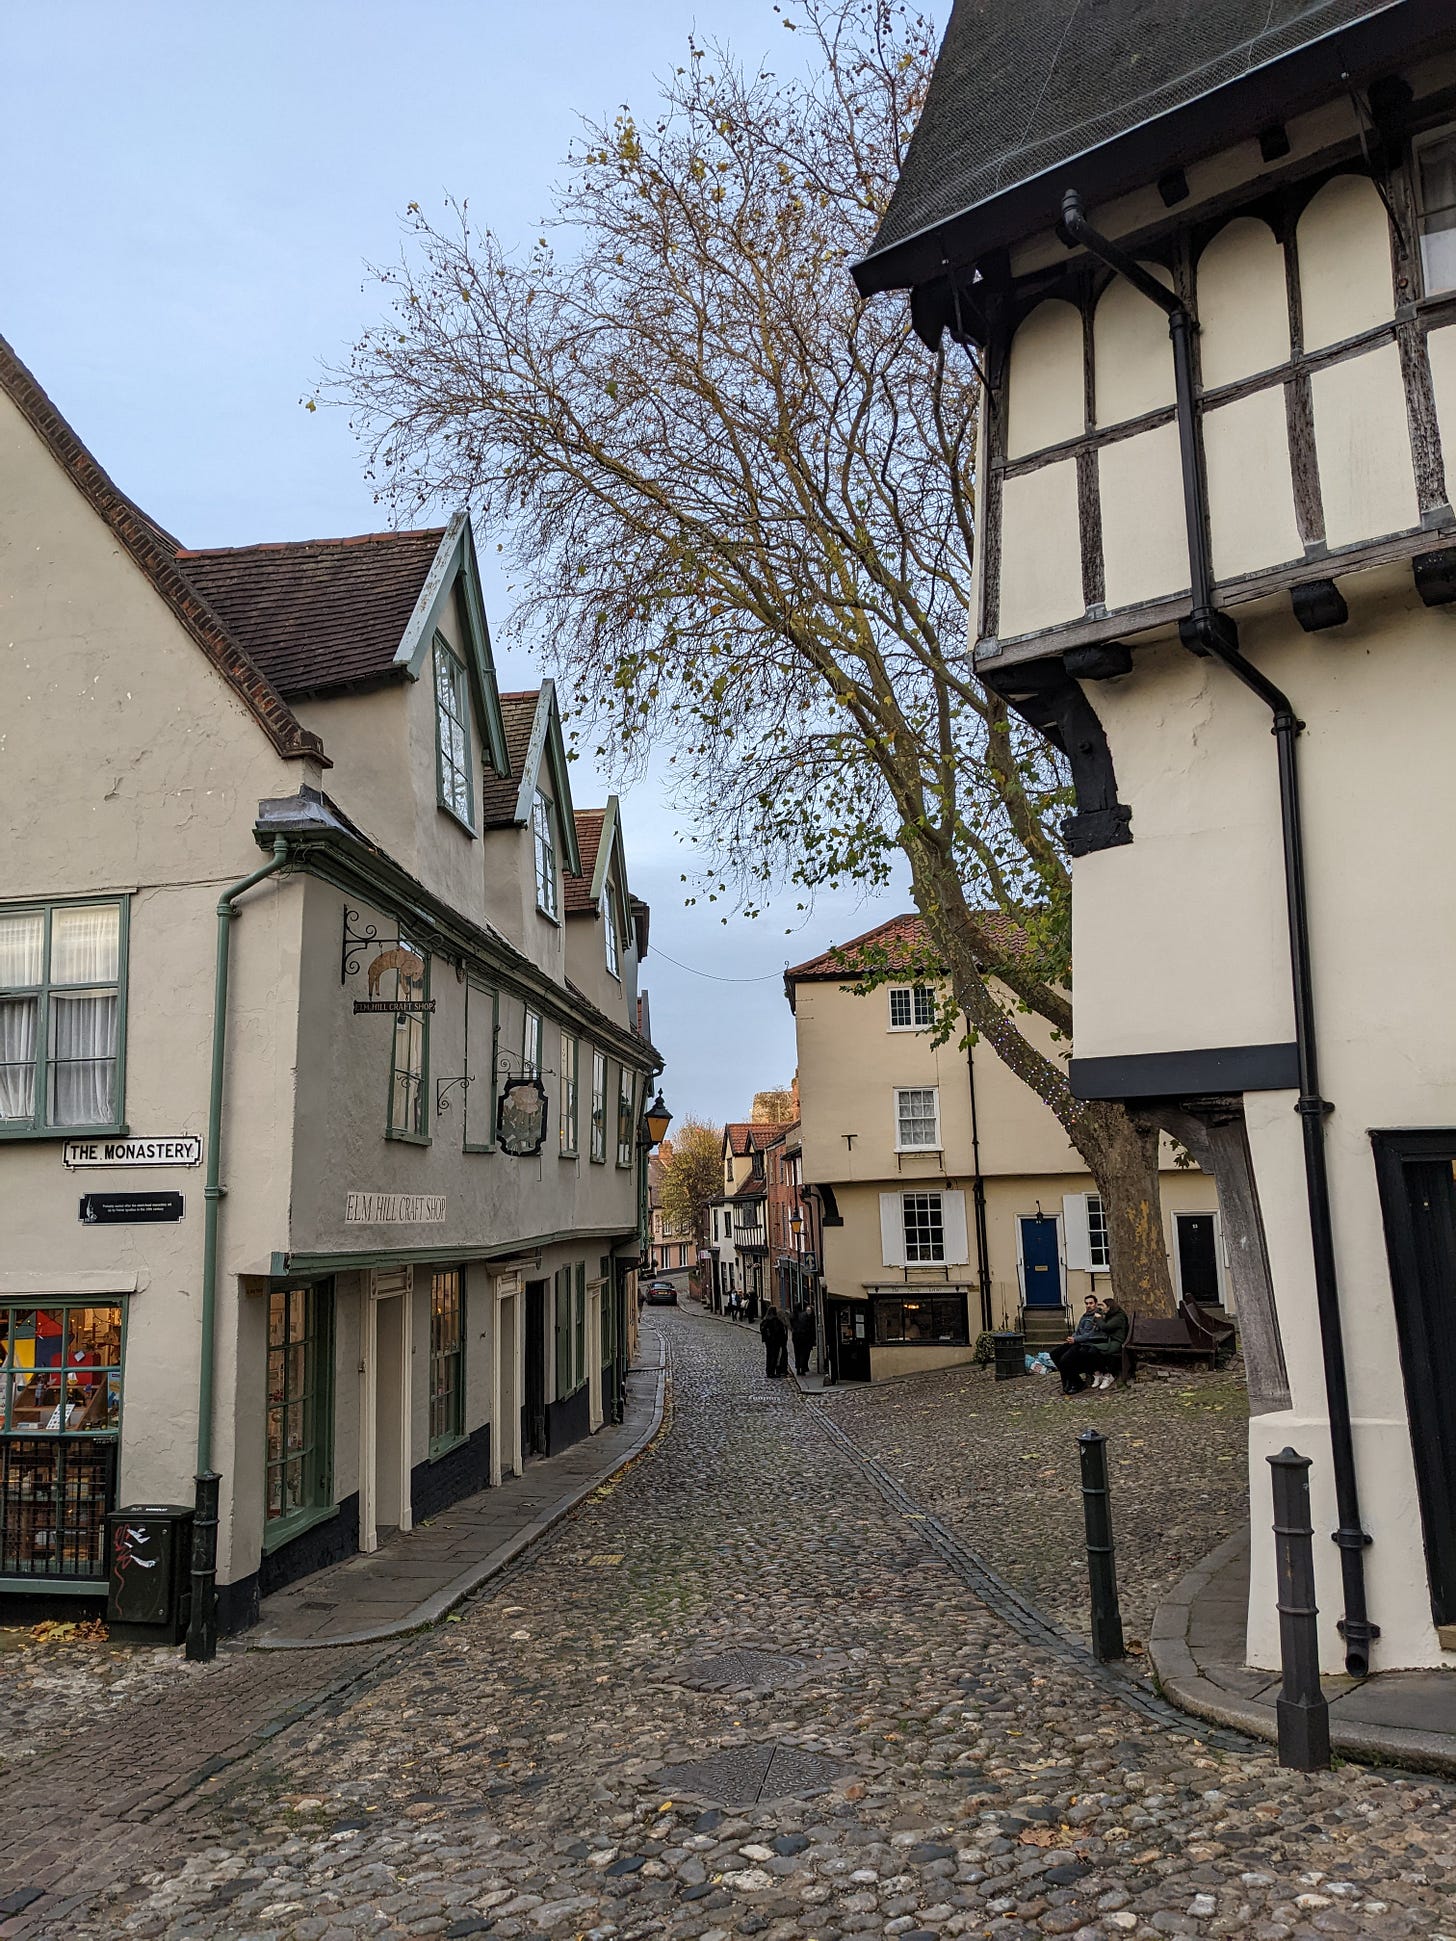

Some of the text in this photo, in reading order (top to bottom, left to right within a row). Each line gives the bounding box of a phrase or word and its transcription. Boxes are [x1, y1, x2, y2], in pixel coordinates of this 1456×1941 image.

[355, 1002, 433, 1012] ELM HILL CRAFT SHOP
[70, 1143, 193, 1160] THE MONASTERY
[346, 1195, 446, 1221] ELM HILL CRAFT SHOP
